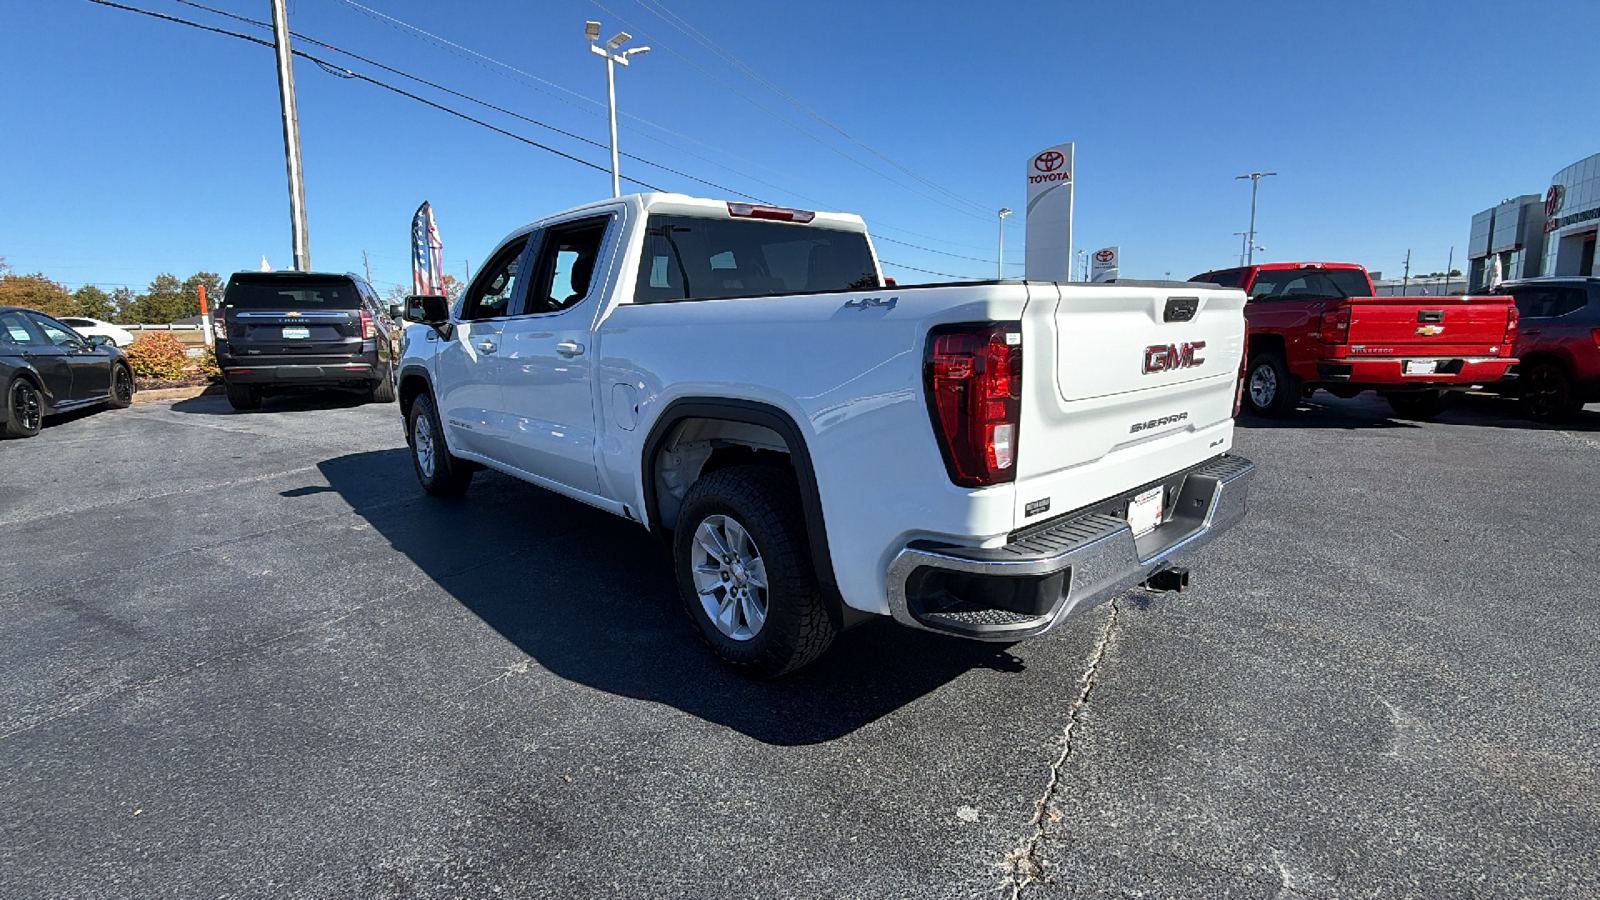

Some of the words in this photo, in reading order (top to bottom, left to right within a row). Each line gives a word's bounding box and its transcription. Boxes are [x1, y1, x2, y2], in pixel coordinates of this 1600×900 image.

[1028, 171, 1069, 184] TOYOTA
[1142, 340, 1206, 375] GMC
[1129, 411, 1188, 434] SIERRA
